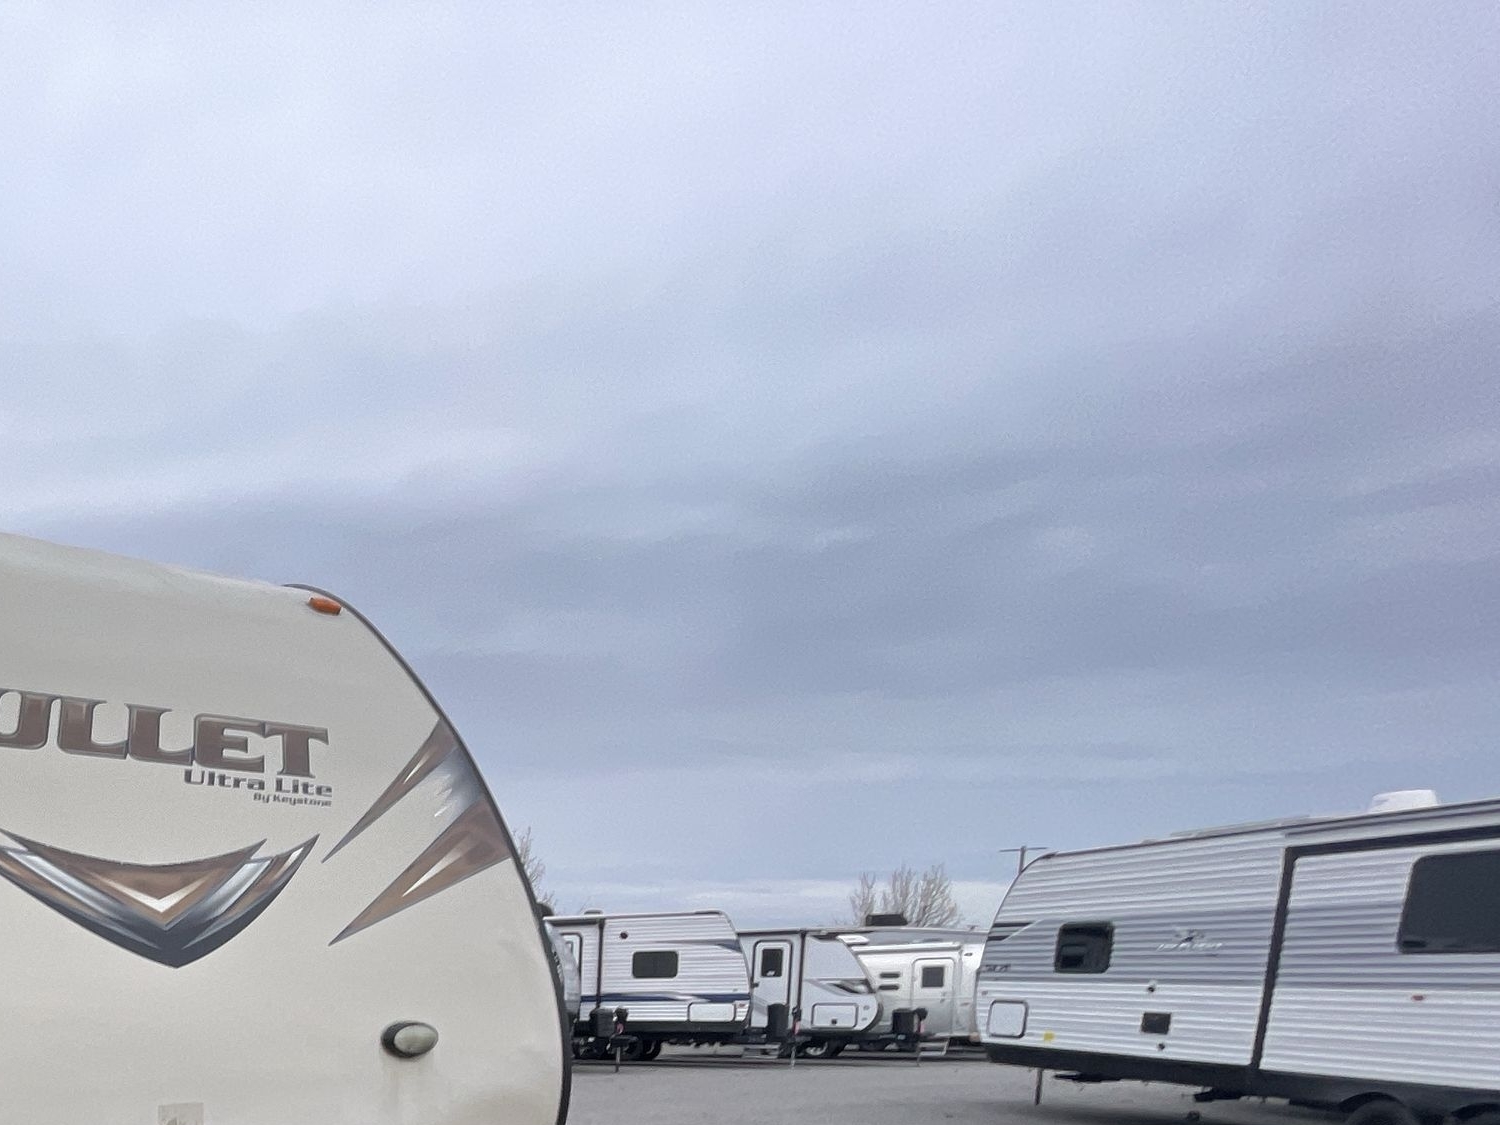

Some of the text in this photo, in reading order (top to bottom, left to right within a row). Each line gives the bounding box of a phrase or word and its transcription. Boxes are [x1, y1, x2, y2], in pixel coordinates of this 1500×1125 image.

[184, 768, 333, 798] Ultra Lite
[253, 792, 332, 807] By Keystone
